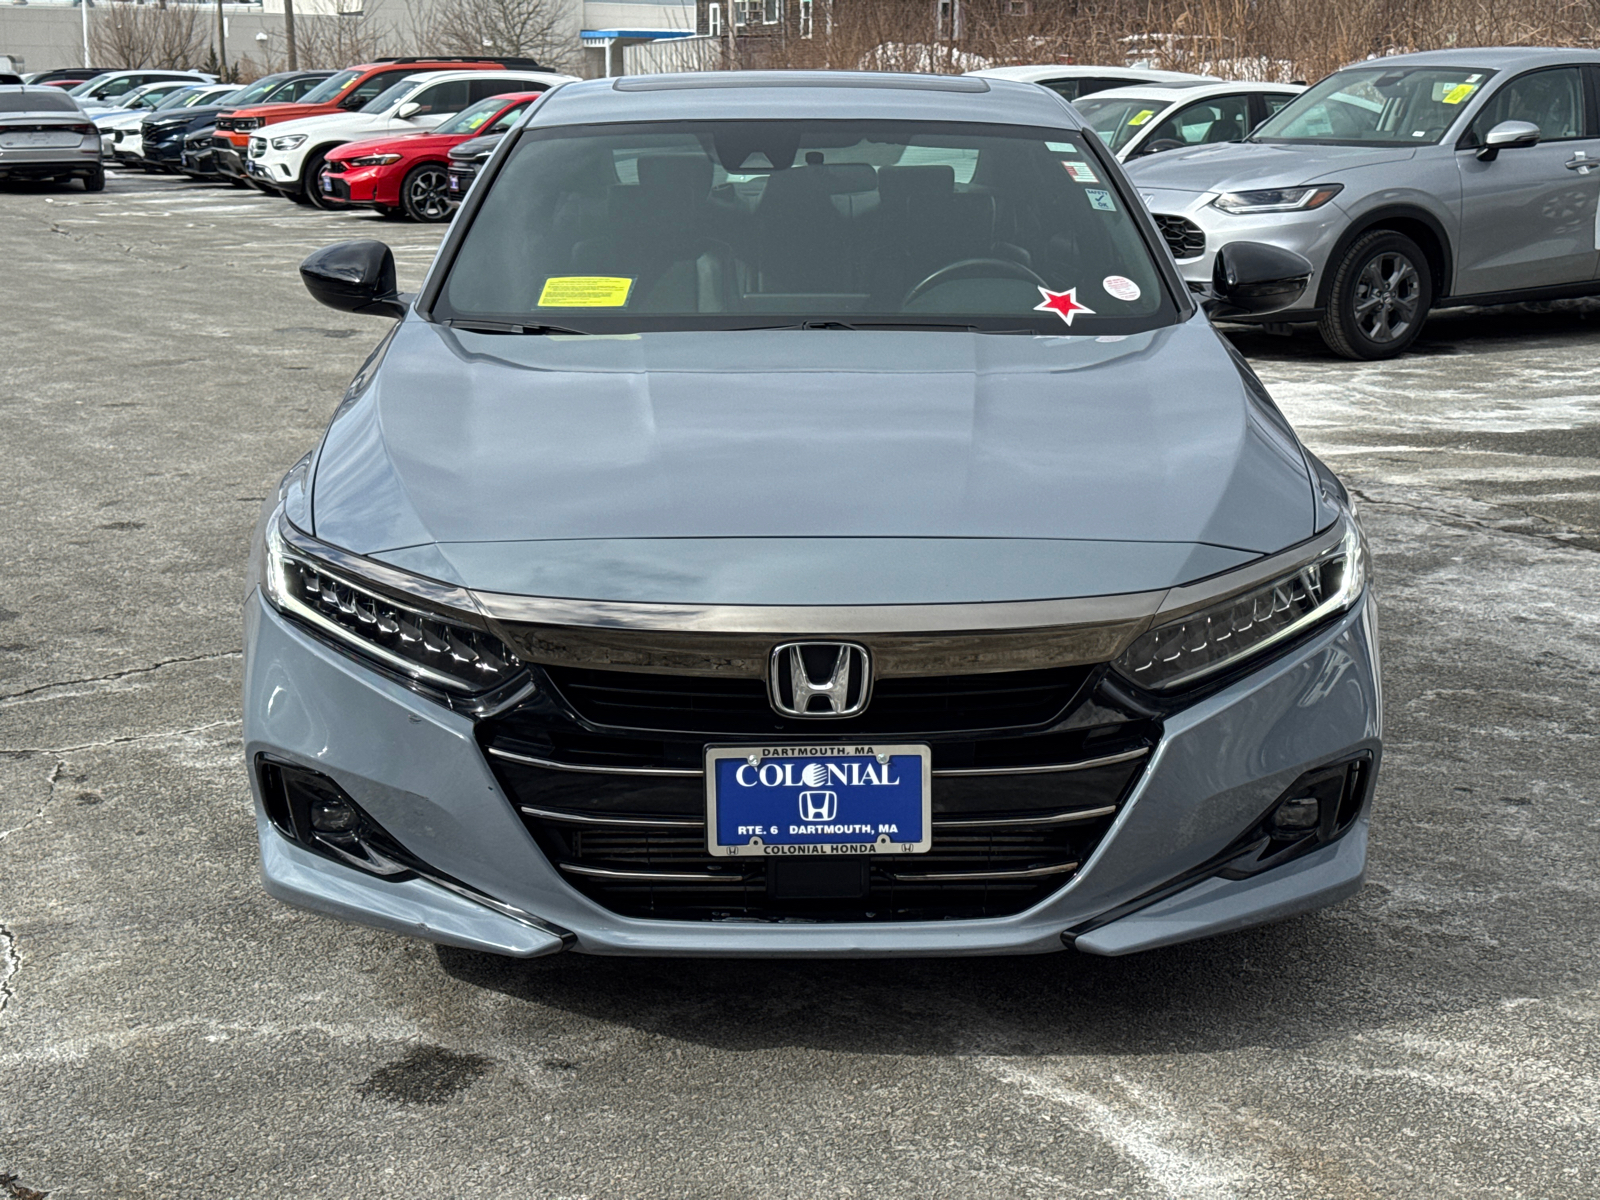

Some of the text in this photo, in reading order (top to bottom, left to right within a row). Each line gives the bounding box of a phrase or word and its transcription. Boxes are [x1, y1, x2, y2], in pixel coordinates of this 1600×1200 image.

[762, 746, 874, 756] DARTMOUTH, MA
[736, 763, 900, 788] COLONIAL
[738, 824, 898, 835] RTE. 6 DARTMOUTH, MA
[764, 844, 876, 854] COLONIAL HONDA
